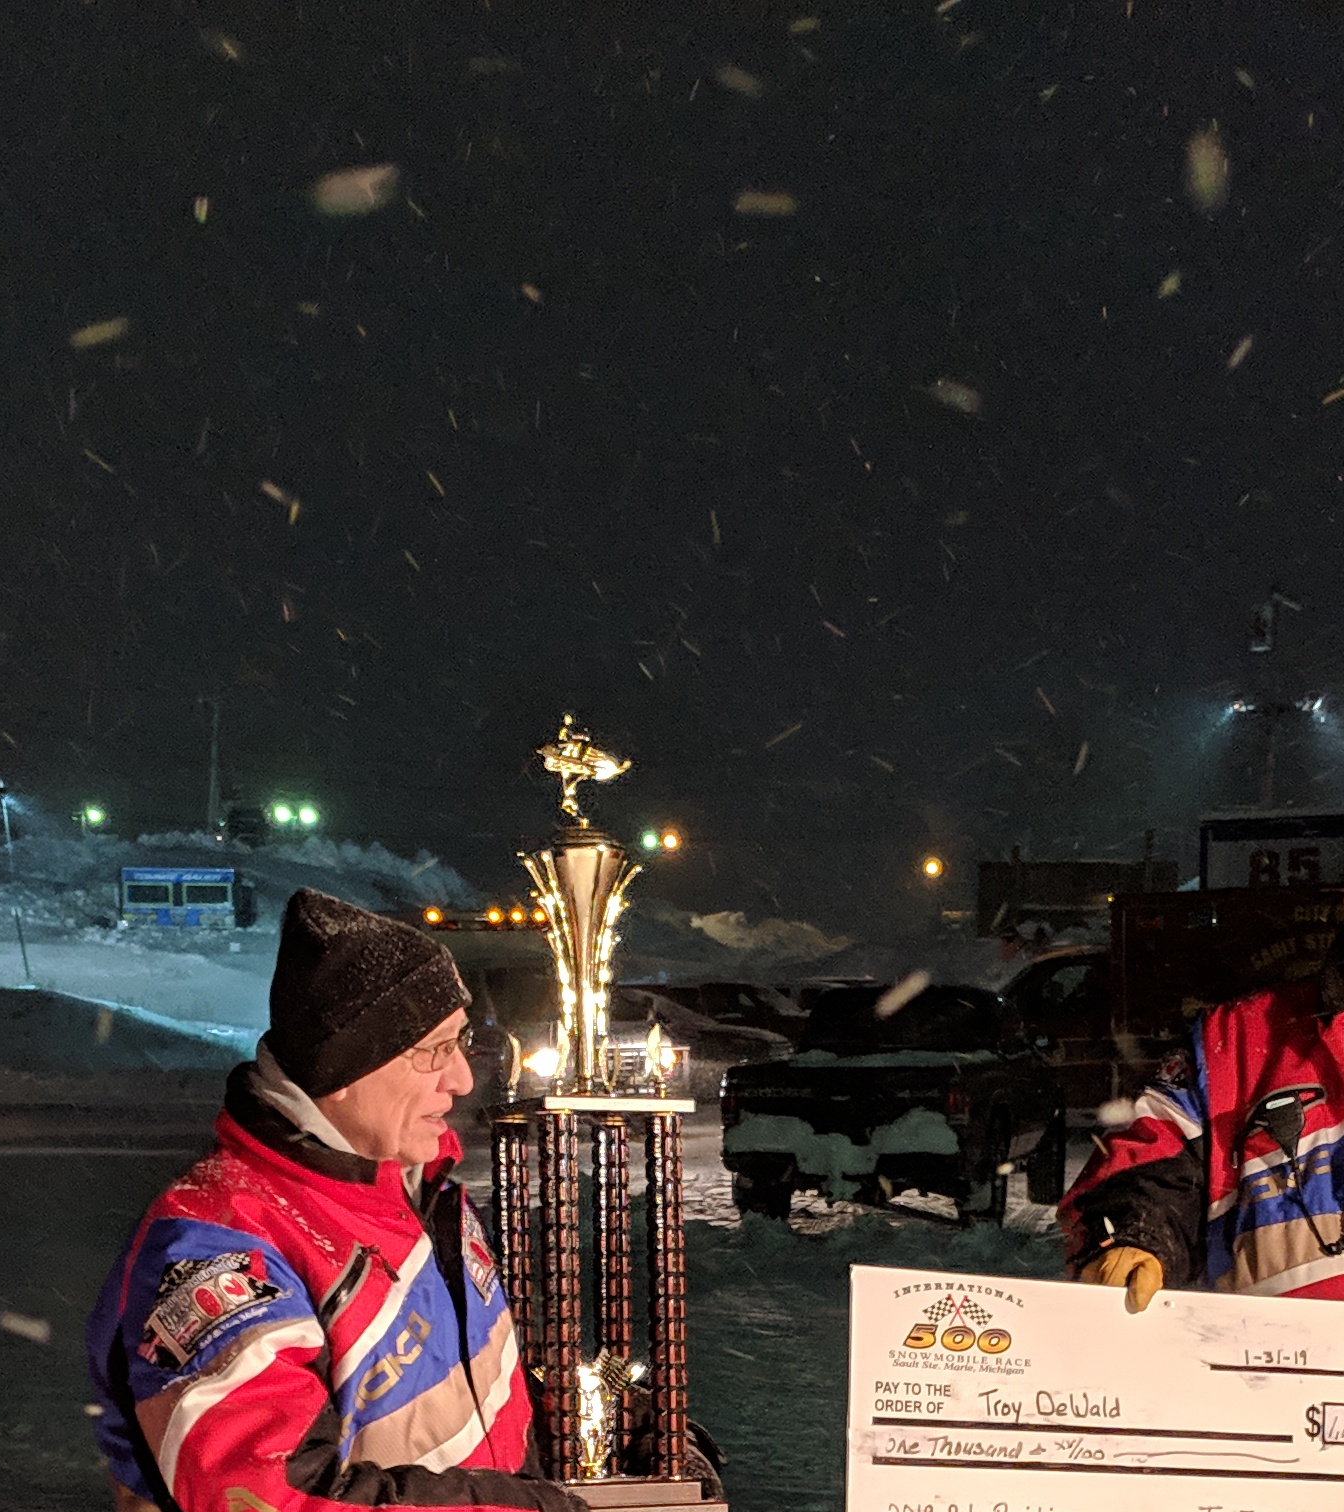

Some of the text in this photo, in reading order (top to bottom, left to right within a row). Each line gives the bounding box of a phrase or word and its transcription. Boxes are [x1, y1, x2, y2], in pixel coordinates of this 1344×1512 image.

[893, 1282, 1025, 1308] INTERNATIONAL
[902, 1323, 1012, 1354] 500
[888, 1350, 1032, 1368] SNOWMOBILE RACE
[892, 1359, 1025, 1376] Sault Ste. Marie, Michigan
[1244, 1349, 1308, 1366] 1-31-19
[875, 1381, 952, 1397] PAY TO THE
[875, 1399, 944, 1414] ORDER OF
[978, 1388, 1121, 1424] Troy DeWald
[1305, 1403, 1321, 1442] $
[927, 1435, 1023, 1459] Thousand
